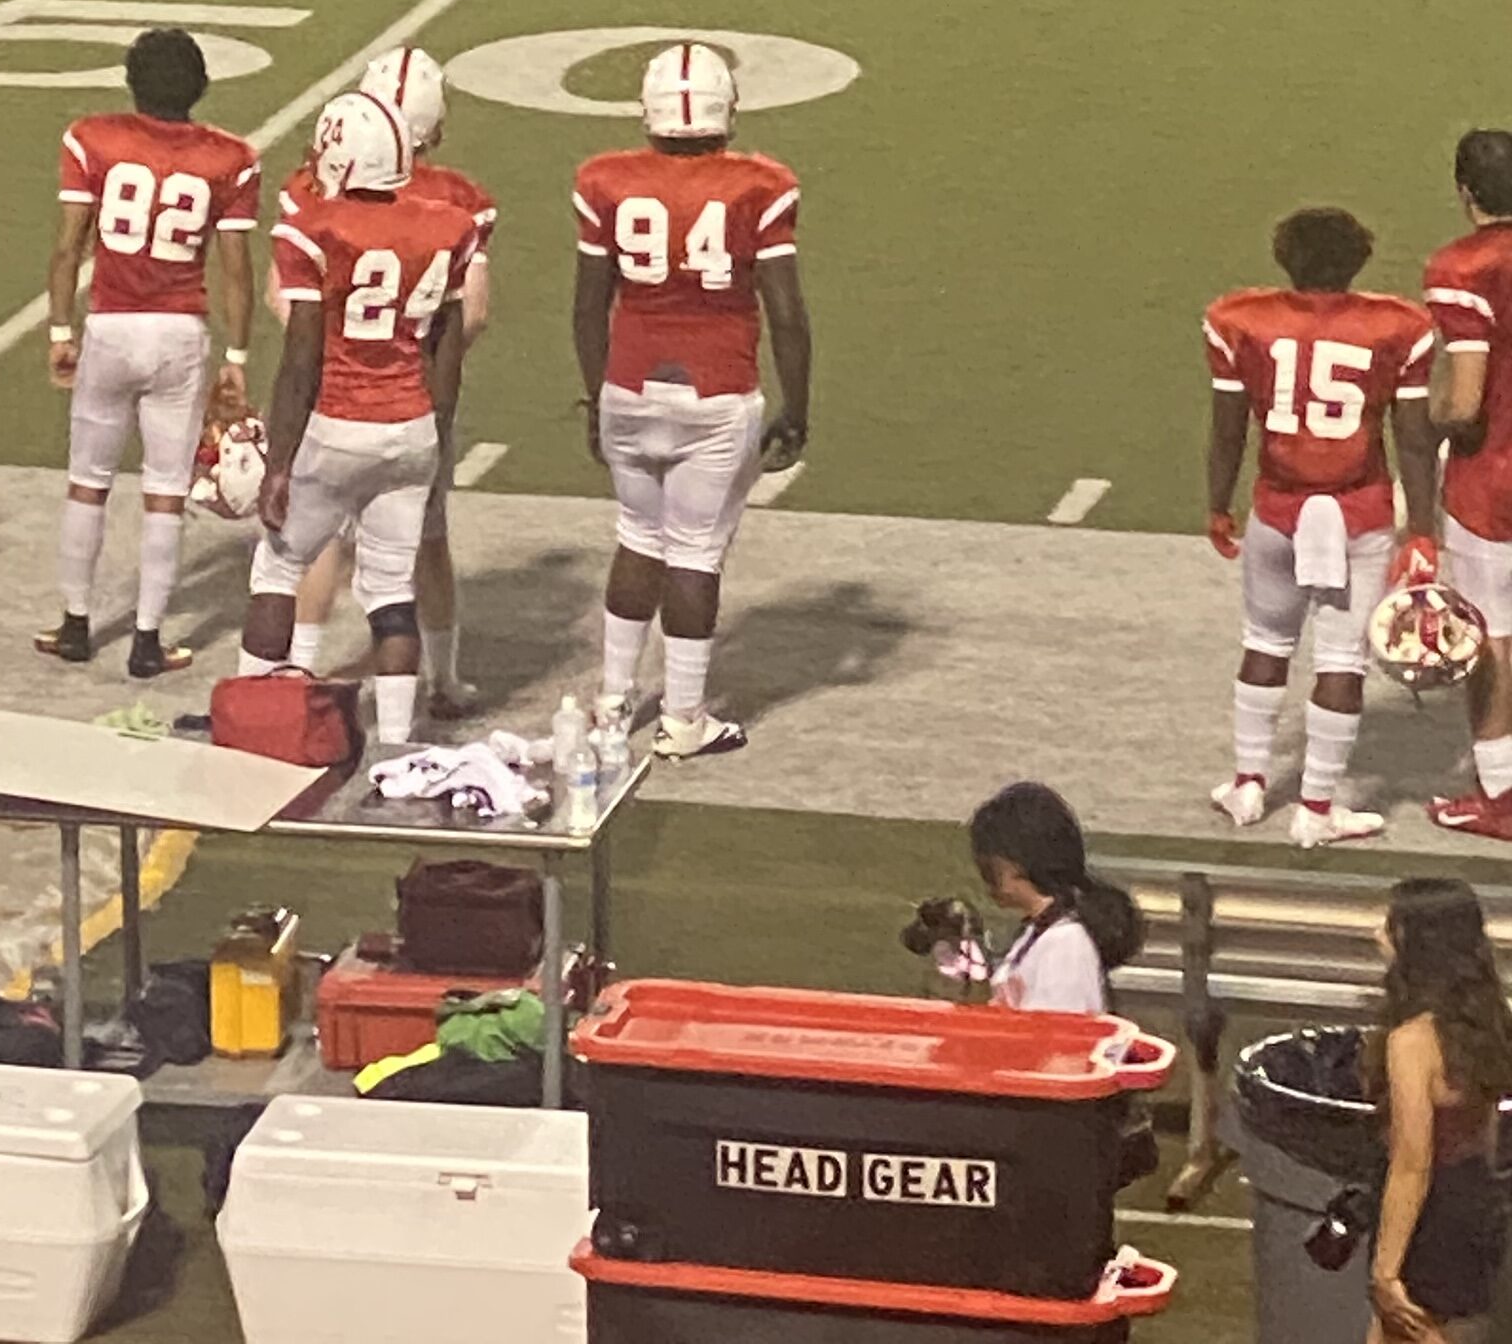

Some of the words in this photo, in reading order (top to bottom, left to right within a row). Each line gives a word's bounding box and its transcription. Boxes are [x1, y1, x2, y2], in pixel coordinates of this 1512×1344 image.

[321, 117, 345, 155] 24
[99, 162, 211, 263] 82
[615, 196, 733, 290] 94
[343, 249, 451, 341] 24
[1265, 337, 1373, 440] 15
[719, 1144, 843, 1193] HEAD
[867, 1158, 992, 1203] GEAR
